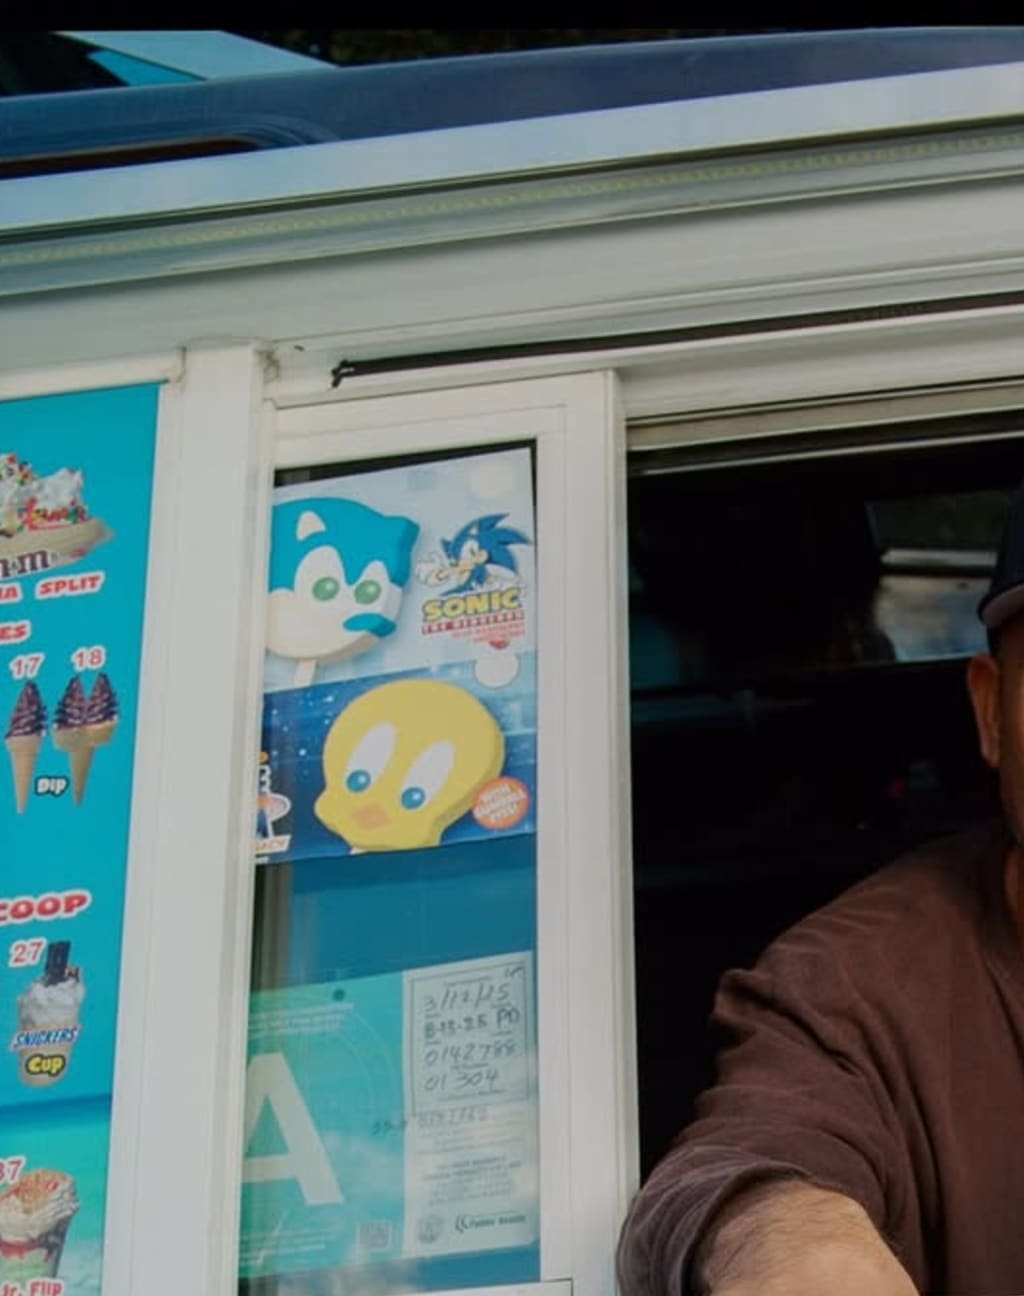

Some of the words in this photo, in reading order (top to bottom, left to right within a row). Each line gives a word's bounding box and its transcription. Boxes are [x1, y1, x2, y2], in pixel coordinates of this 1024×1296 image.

[37, 573, 102, 597] SPLIT
[421, 586, 522, 622] SONIC
[11, 653, 42, 678] 17
[73, 647, 104, 670] 18
[36, 776, 67, 796] Dip
[12, 939, 44, 966] 27
[12, 1026, 79, 1049] SNICKERS
[26, 1054, 66, 1077] Cup
[240, 1051, 345, 1207] A
